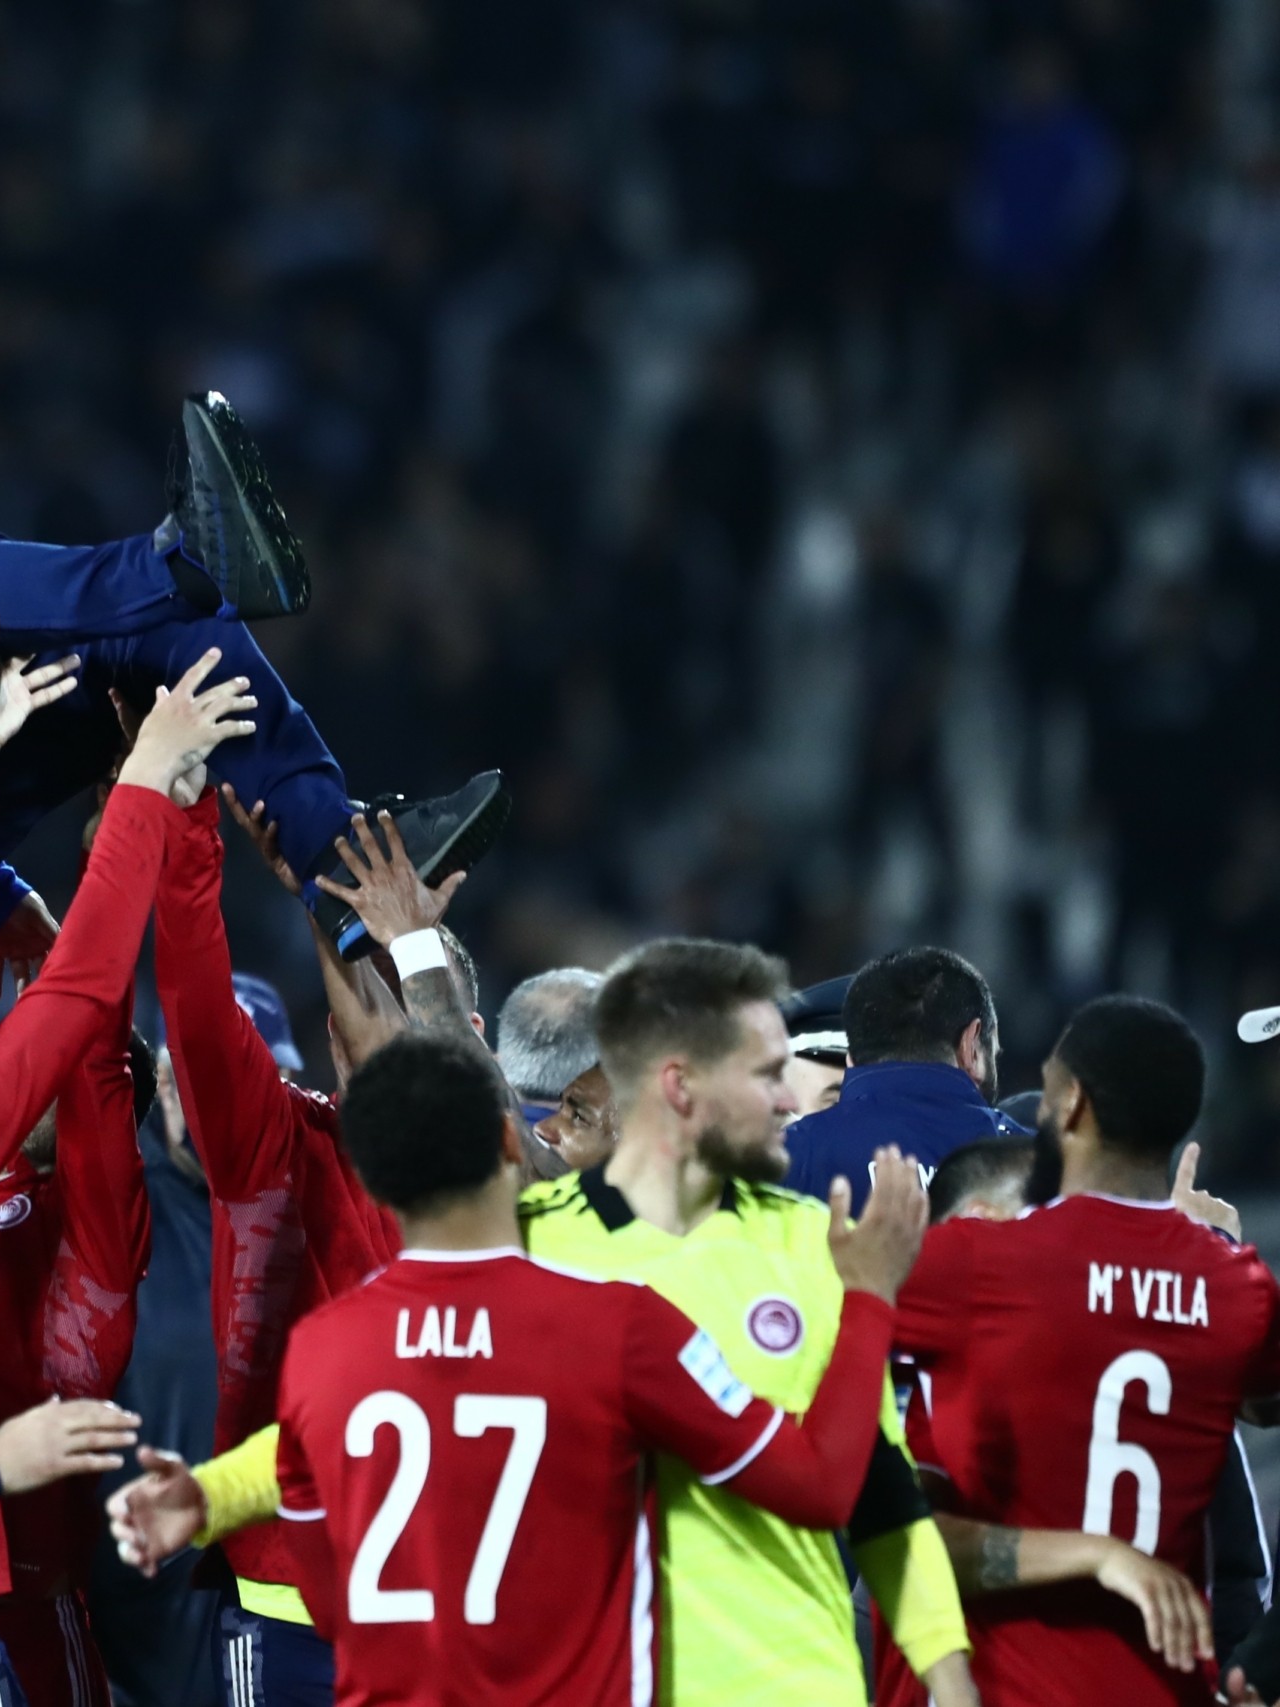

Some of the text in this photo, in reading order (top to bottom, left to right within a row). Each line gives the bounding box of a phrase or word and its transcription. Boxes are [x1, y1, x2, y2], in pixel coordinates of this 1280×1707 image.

[395, 1305, 493, 1359] LALA
[345, 1390, 547, 1625] 27
[1082, 1349, 1172, 1557] 6
